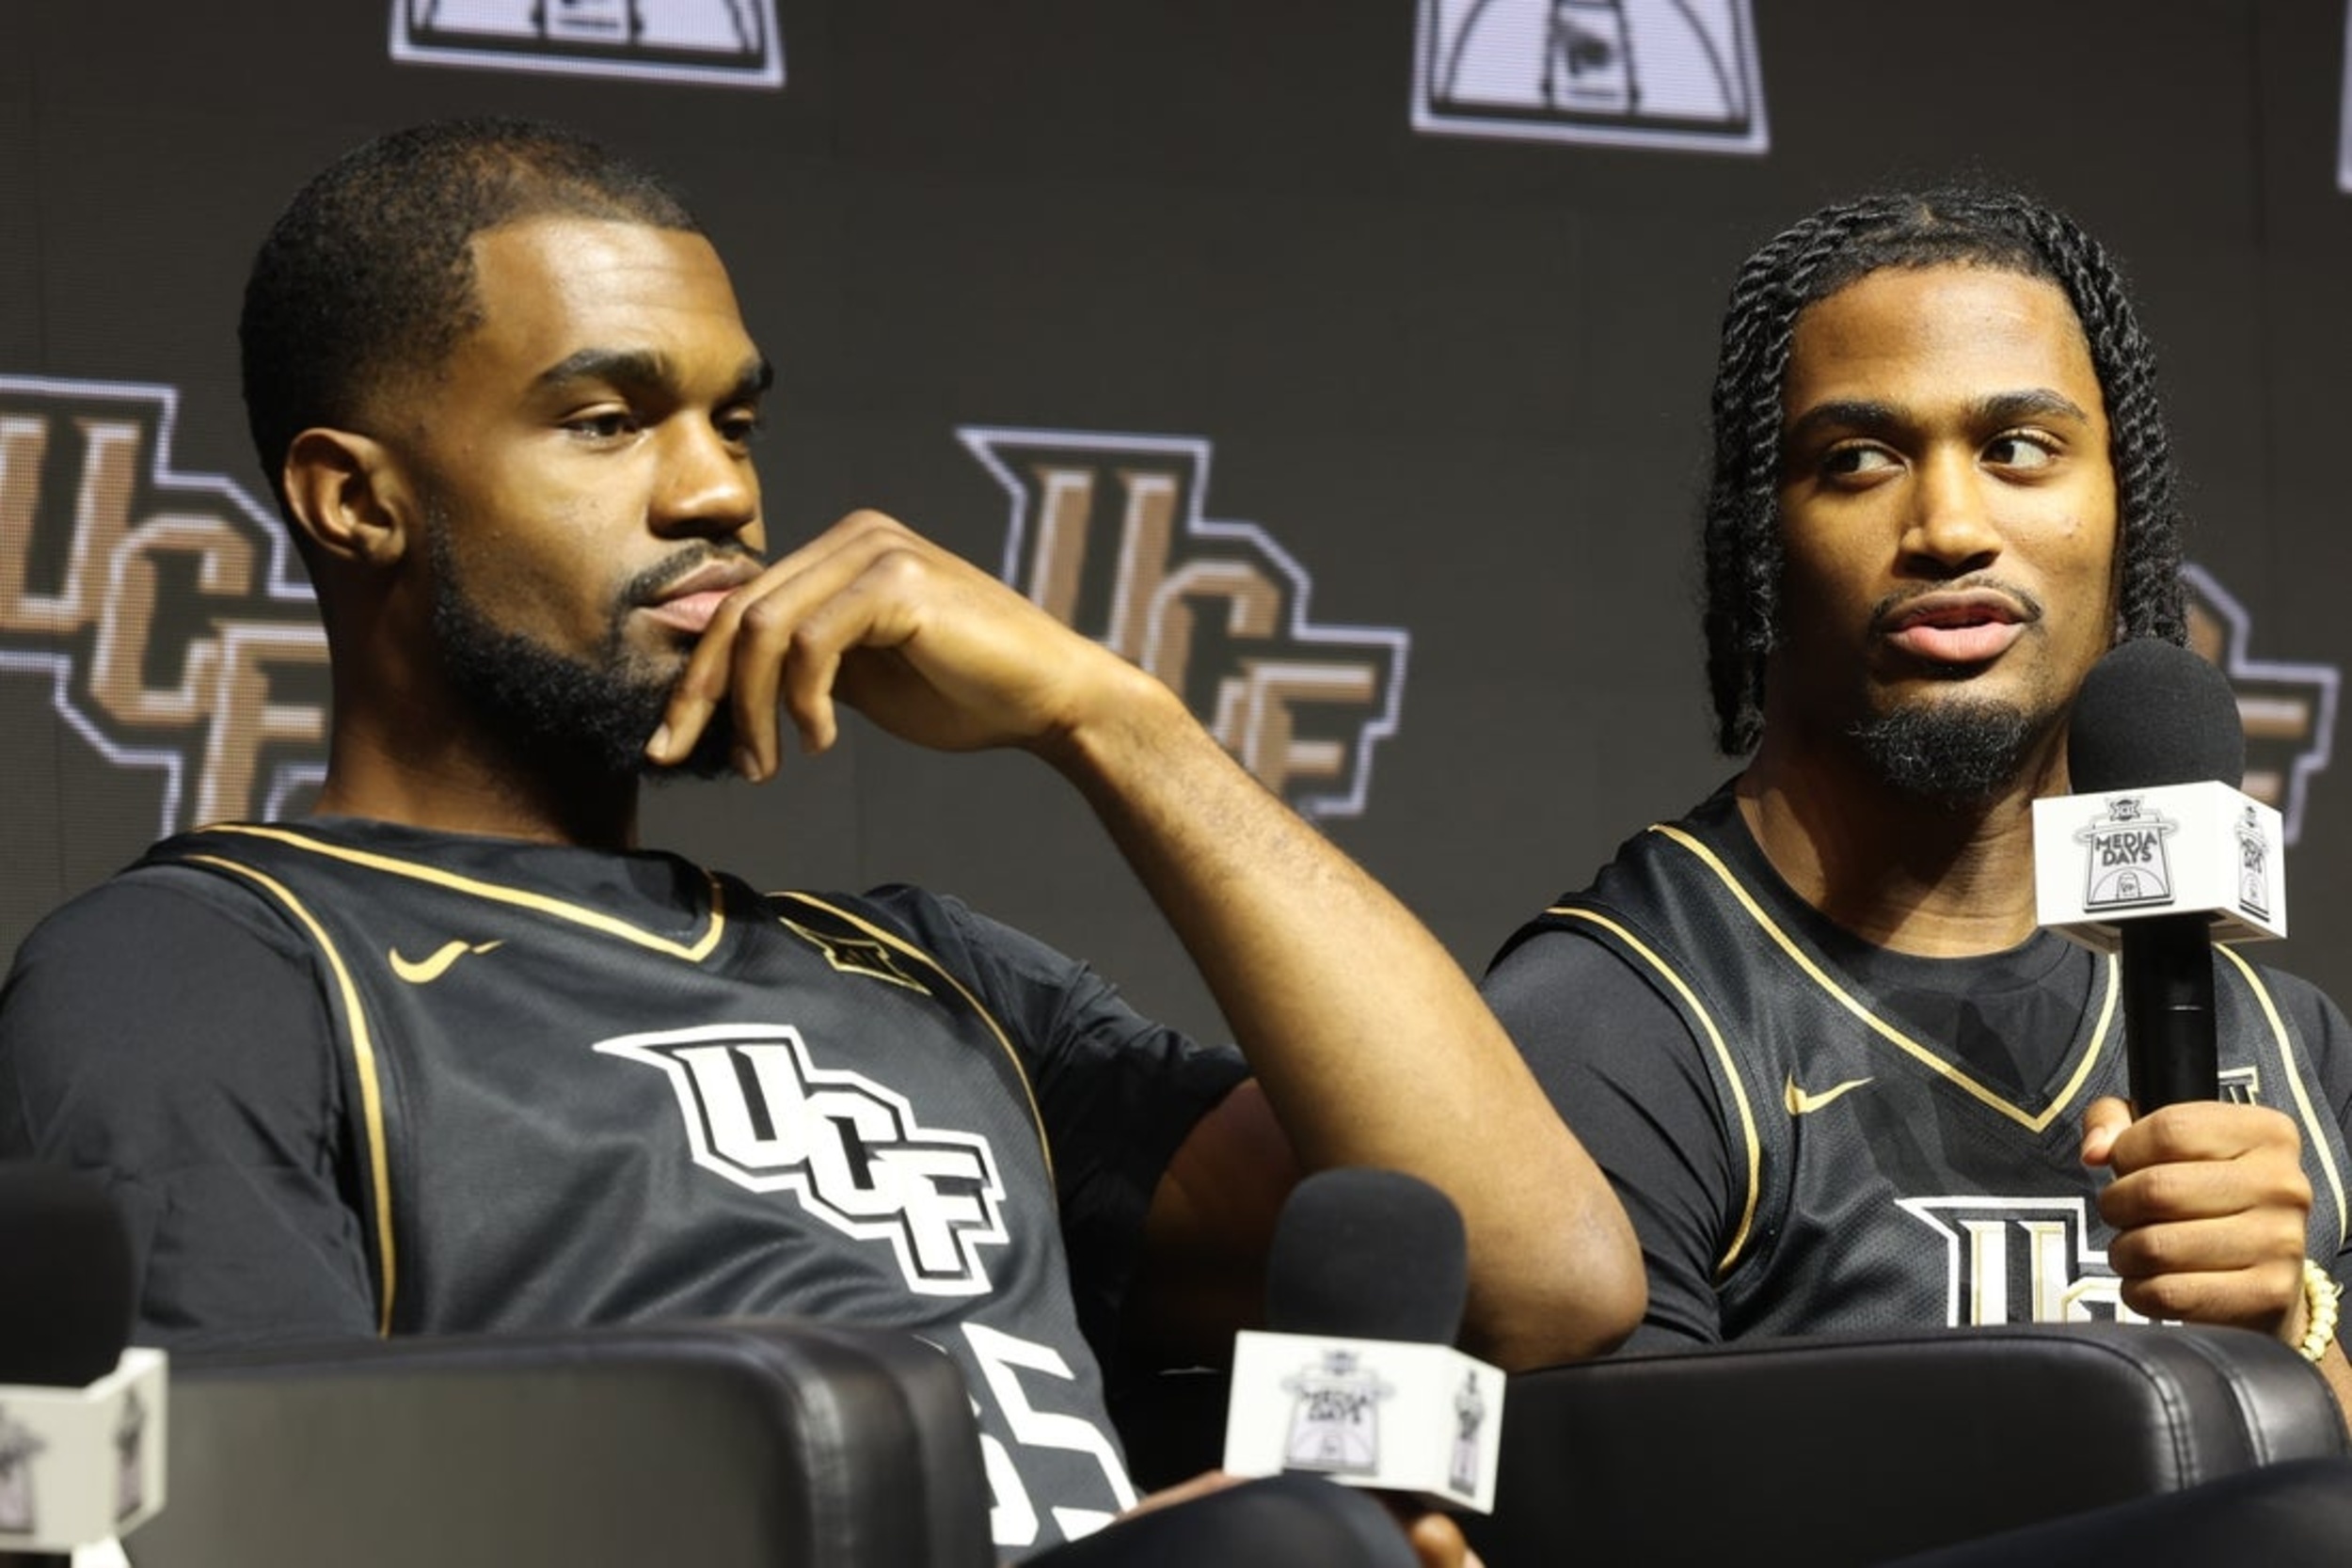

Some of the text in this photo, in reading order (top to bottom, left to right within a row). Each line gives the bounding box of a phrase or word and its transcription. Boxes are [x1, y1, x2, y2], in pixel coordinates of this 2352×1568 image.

[2095, 832, 2157, 851] MEDIA
[2102, 847, 2153, 866] DAYS
[663, 1037, 994, 1279] UCF
